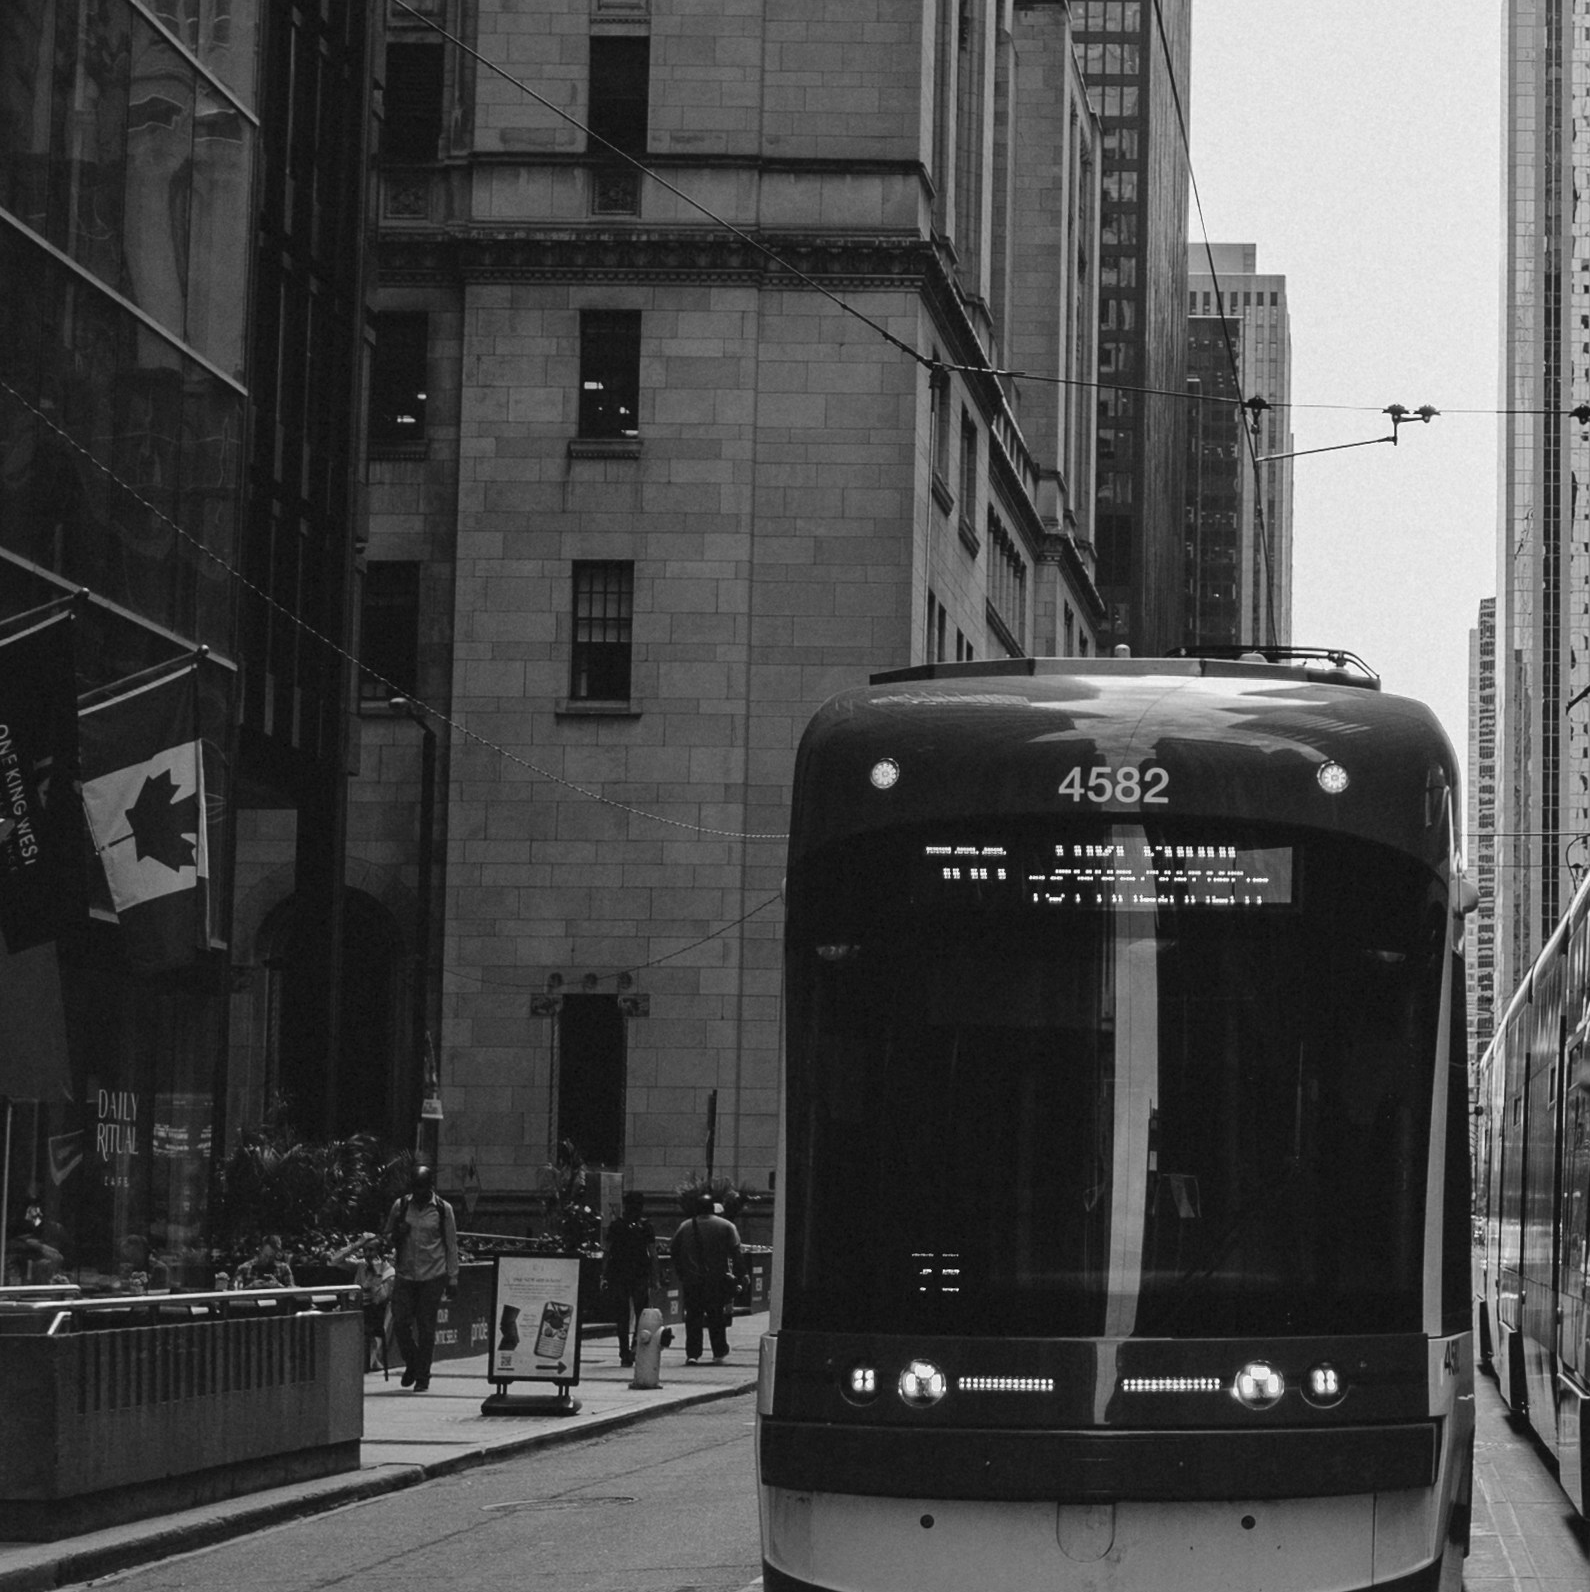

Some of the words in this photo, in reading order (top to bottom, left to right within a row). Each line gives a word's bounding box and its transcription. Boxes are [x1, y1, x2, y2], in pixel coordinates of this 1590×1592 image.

[5, 766, 28, 816] KING
[1058, 766, 1171, 805] 4582
[97, 1088, 140, 1121] DAILY
[96, 1122, 139, 1162] RITUAL
[470, 1316, 489, 1348] pride
